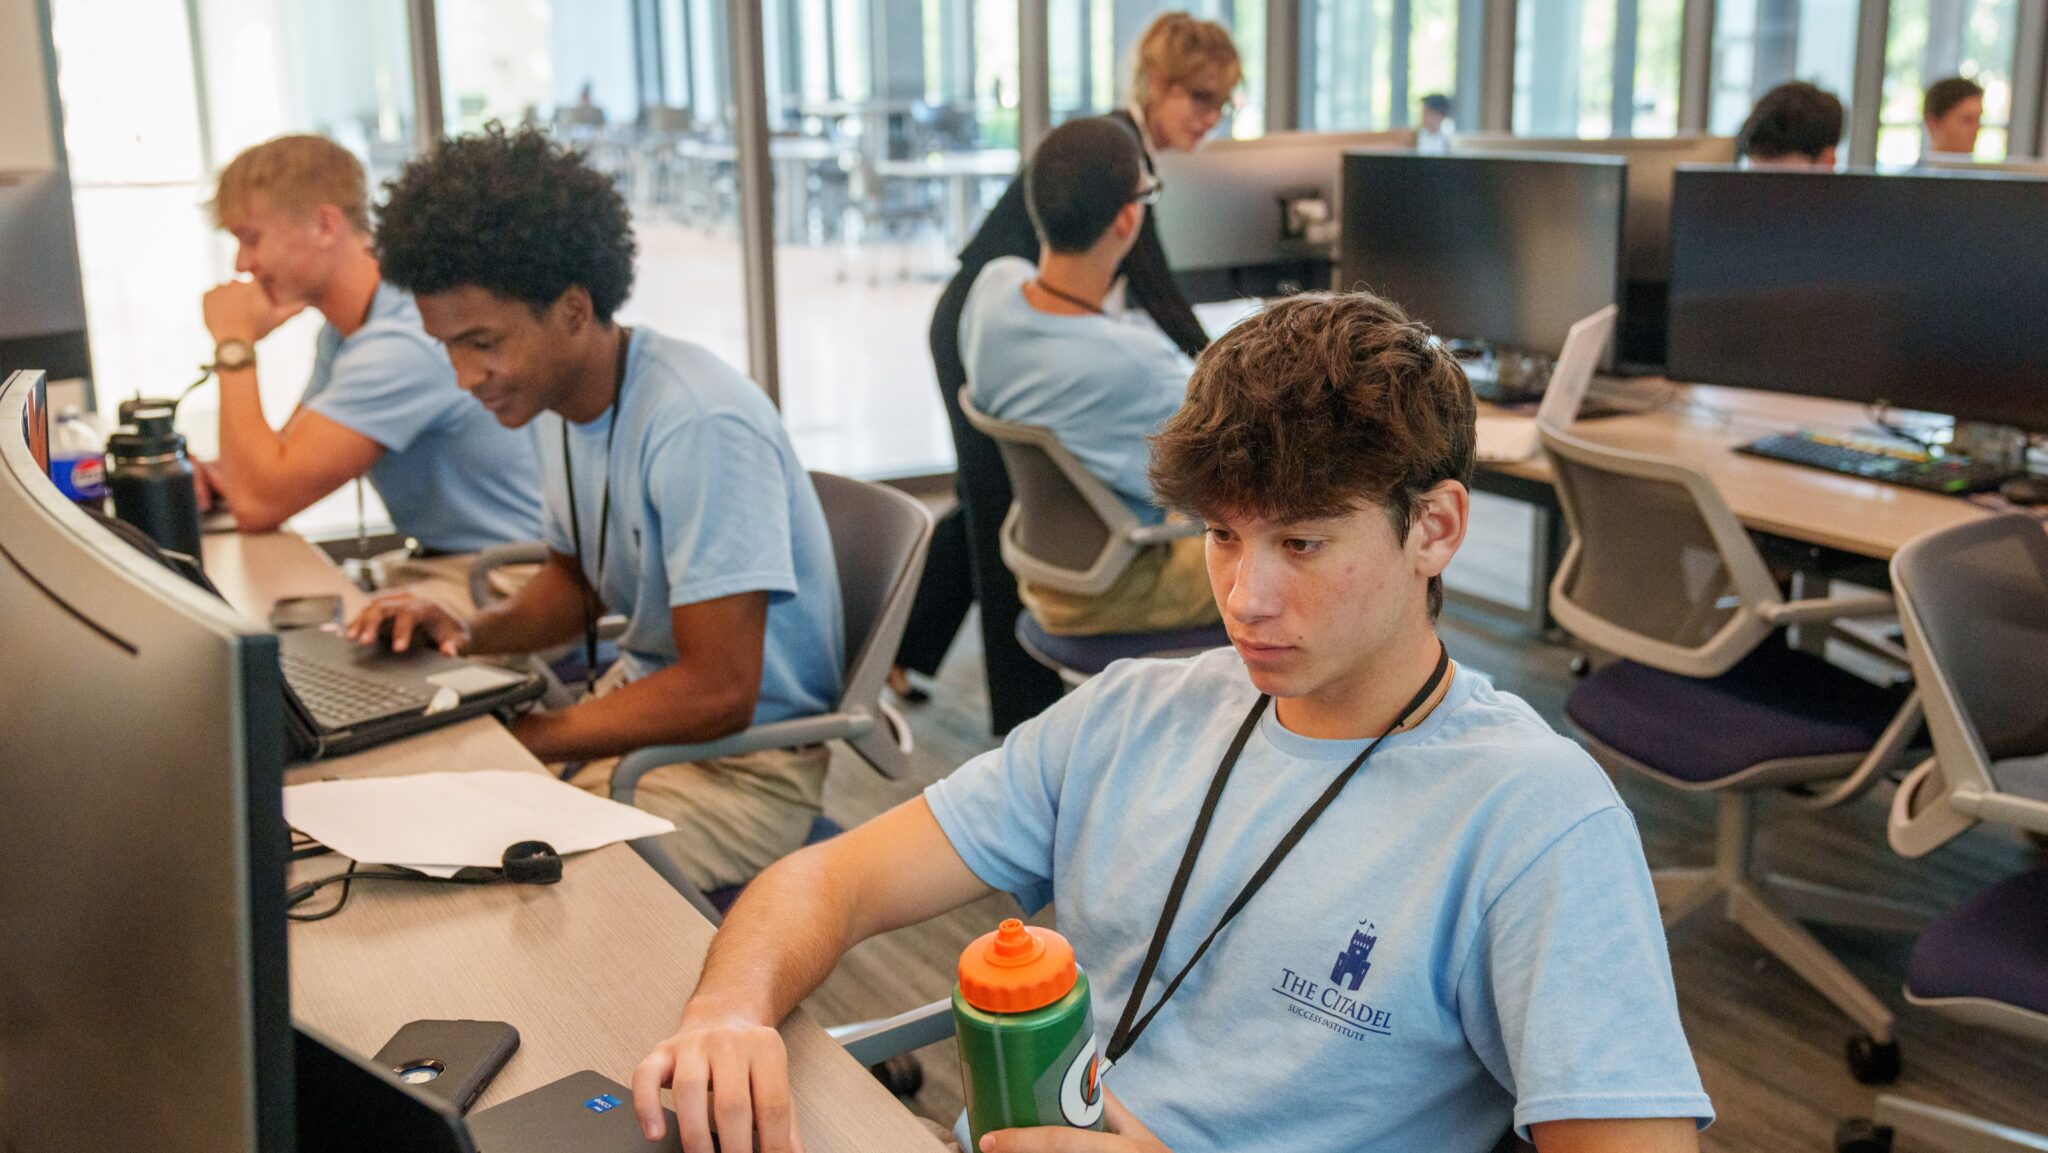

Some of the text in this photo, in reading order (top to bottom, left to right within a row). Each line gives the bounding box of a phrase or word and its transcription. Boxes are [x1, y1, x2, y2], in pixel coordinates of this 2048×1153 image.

[1280, 968, 1392, 1029] THE CITADEL
[1288, 1003, 1366, 1042] SUCCESS INSTITUTE
